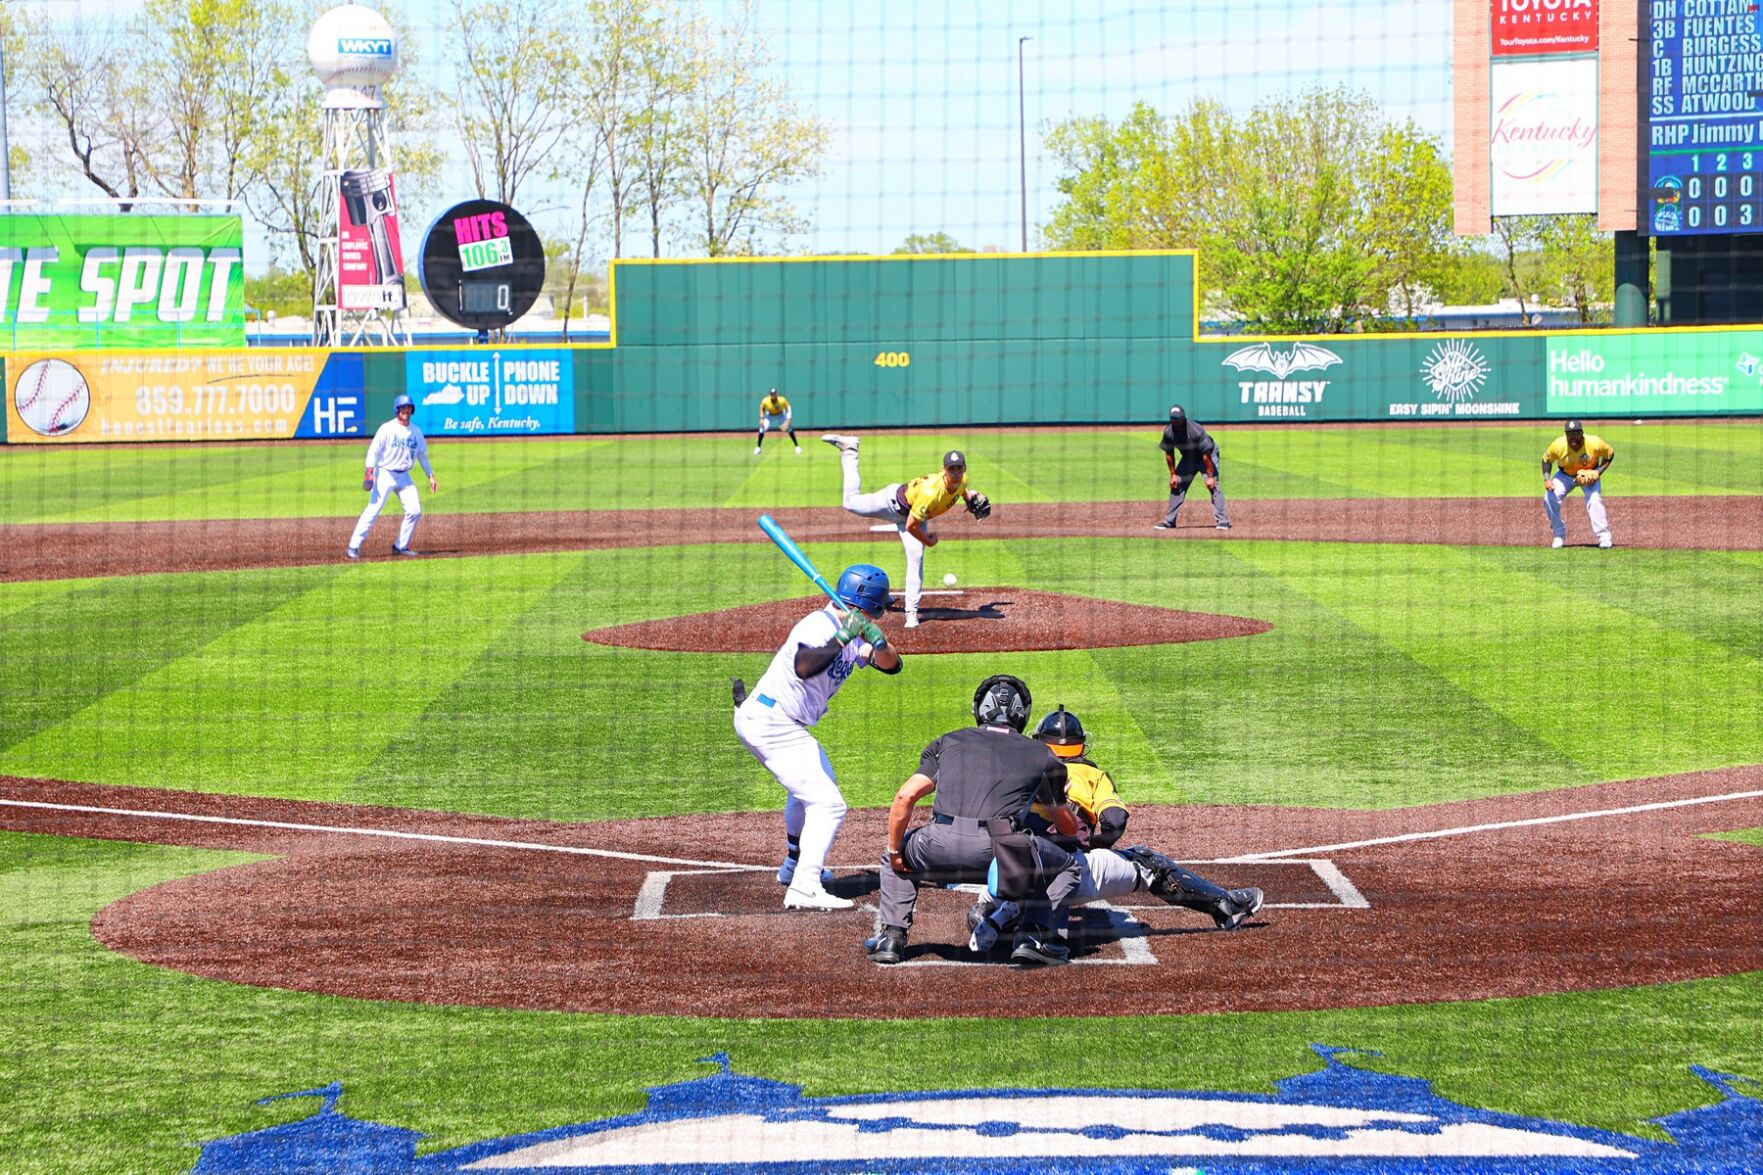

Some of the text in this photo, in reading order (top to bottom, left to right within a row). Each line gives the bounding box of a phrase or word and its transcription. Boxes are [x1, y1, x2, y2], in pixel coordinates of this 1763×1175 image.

[1499, 11, 1592, 25] KENTUCKY
[1653, 0, 1676, 19] DH
[1653, 15, 1755, 39] 3B FUENTES
[340, 40, 390, 53] WKYT
[1500, 34, 1590, 47] TourToyota.com/Kentucky
[1652, 34, 1761, 59] C BURGESS
[1652, 58, 1672, 77] 1B
[1652, 77, 1673, 96] RF
[1652, 92, 1755, 115] SS ATWOOD
[1490, 117, 1598, 149] Kentucky
[1652, 124, 1689, 146] RHP
[1691, 123, 1754, 144] Jimmy
[1691, 152, 1753, 172] 1 2 3
[1688, 175, 1753, 199] 0 0 0
[1688, 206, 1700, 227] 0
[1714, 205, 1727, 226] 0
[1740, 204, 1752, 225] 3
[454, 211, 508, 244] HITS
[77, 247, 241, 323] SPOT
[497, 284, 509, 310] 0
[248, 356, 282, 372] YOUR
[874, 351, 910, 368] 400
[1550, 349, 1605, 373] Hello
[422, 361, 490, 384] BUCKLE
[503, 360, 560, 382] PHONE
[136, 384, 297, 415] 859.777.7000
[466, 384, 491, 406] UP
[504, 384, 559, 405] DOWN
[1238, 381, 1327, 404] TRANSY
[314, 396, 358, 433] HF
[1258, 405, 1306, 417] BASEBALL
[1389, 402, 1520, 415] EASY SIPIN' MOONSHINE
[444, 415, 541, 432] Be safe, Kentucky.
